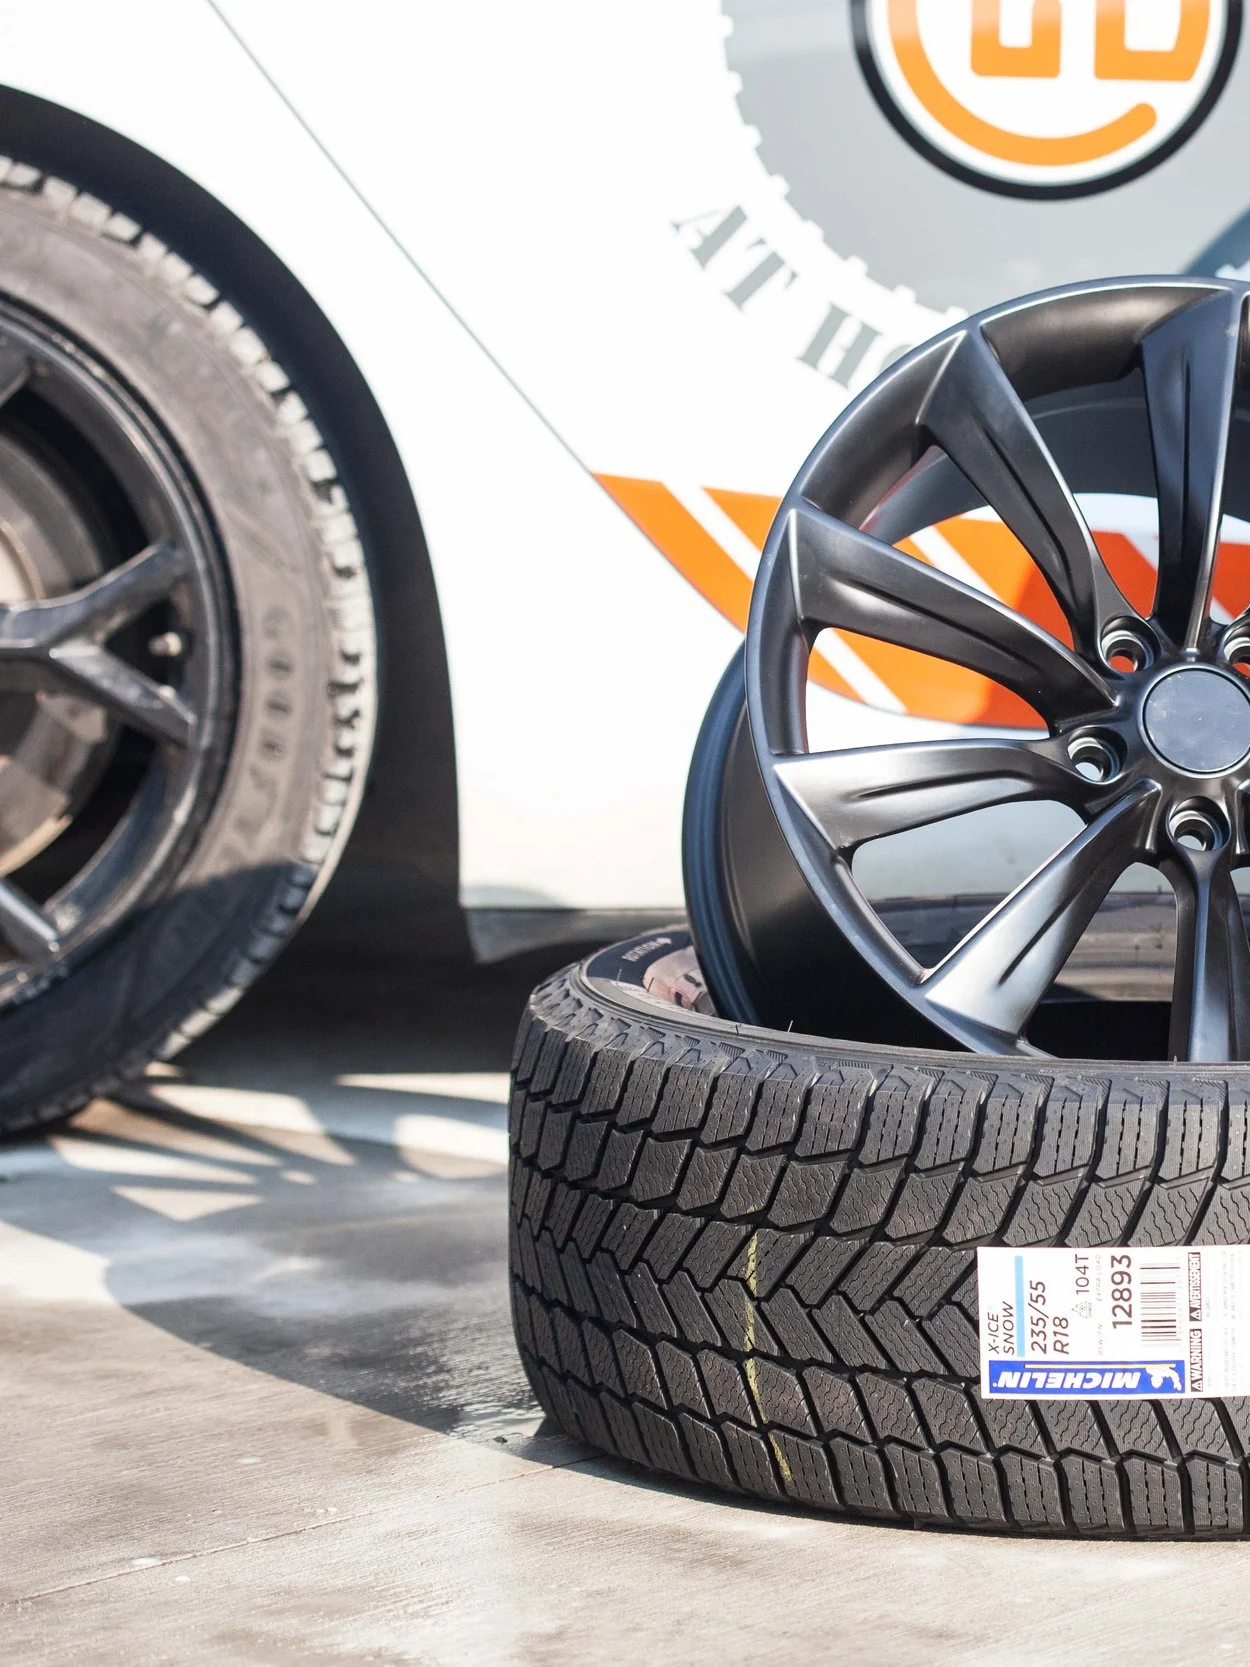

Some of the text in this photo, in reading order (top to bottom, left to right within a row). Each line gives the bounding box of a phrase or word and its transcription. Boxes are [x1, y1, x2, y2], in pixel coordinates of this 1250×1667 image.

[671, 204, 799, 315] AT
[1075, 1253, 1090, 1295] 104T
[1110, 1254, 1132, 1329] 12893
[1189, 1252, 1201, 1308] AVERTISSEMENT
[987, 1312, 1000, 1354] X-ICE
[1002, 1301, 1015, 1355] SNOW
[1028, 1280, 1049, 1354] 235/55
[1052, 1316, 1069, 1355] R18
[997, 1371, 1141, 1389] MICHELIN
[1190, 1329, 1203, 1381] WARNING
